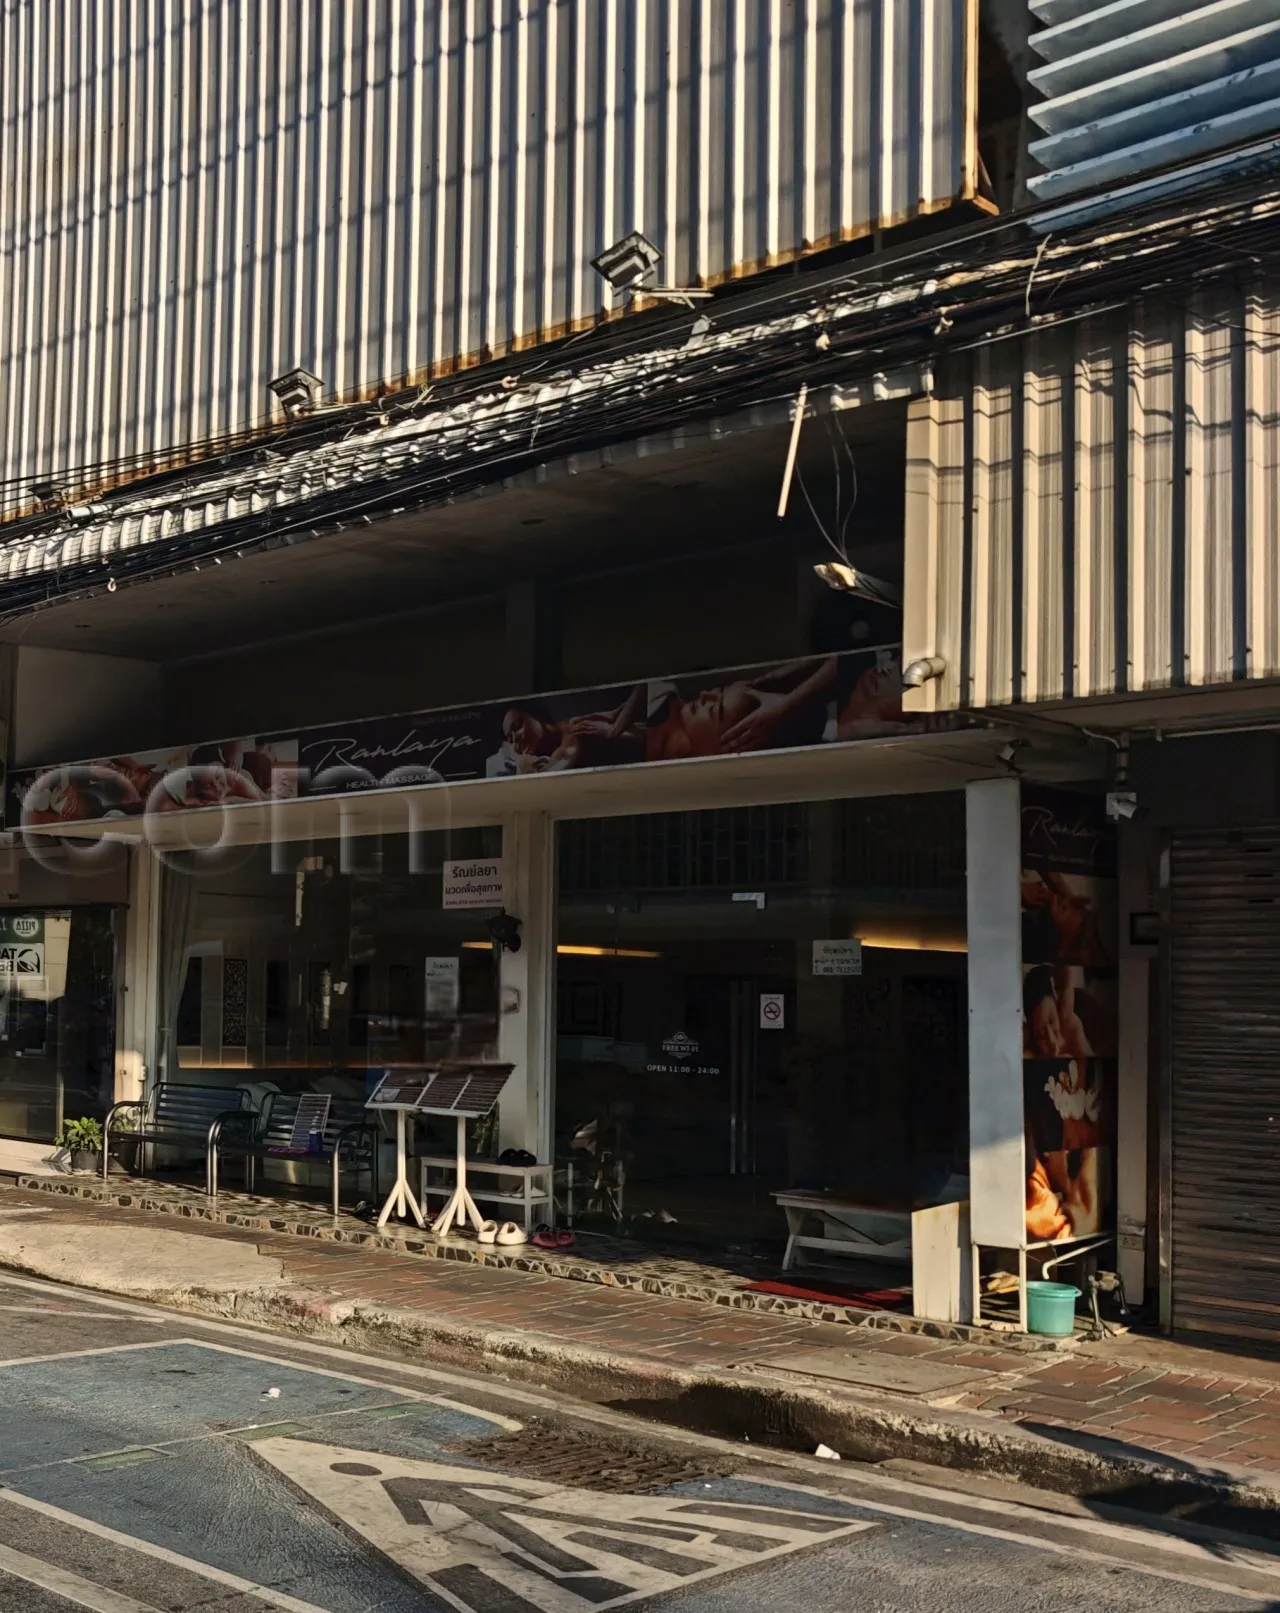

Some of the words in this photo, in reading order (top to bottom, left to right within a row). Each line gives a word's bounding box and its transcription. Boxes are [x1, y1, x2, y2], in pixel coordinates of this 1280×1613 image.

[302, 729, 482, 773] Ranlaya
[385, 773, 437, 785] MASSAGE
[646, 1064, 667, 1073] OPEN
